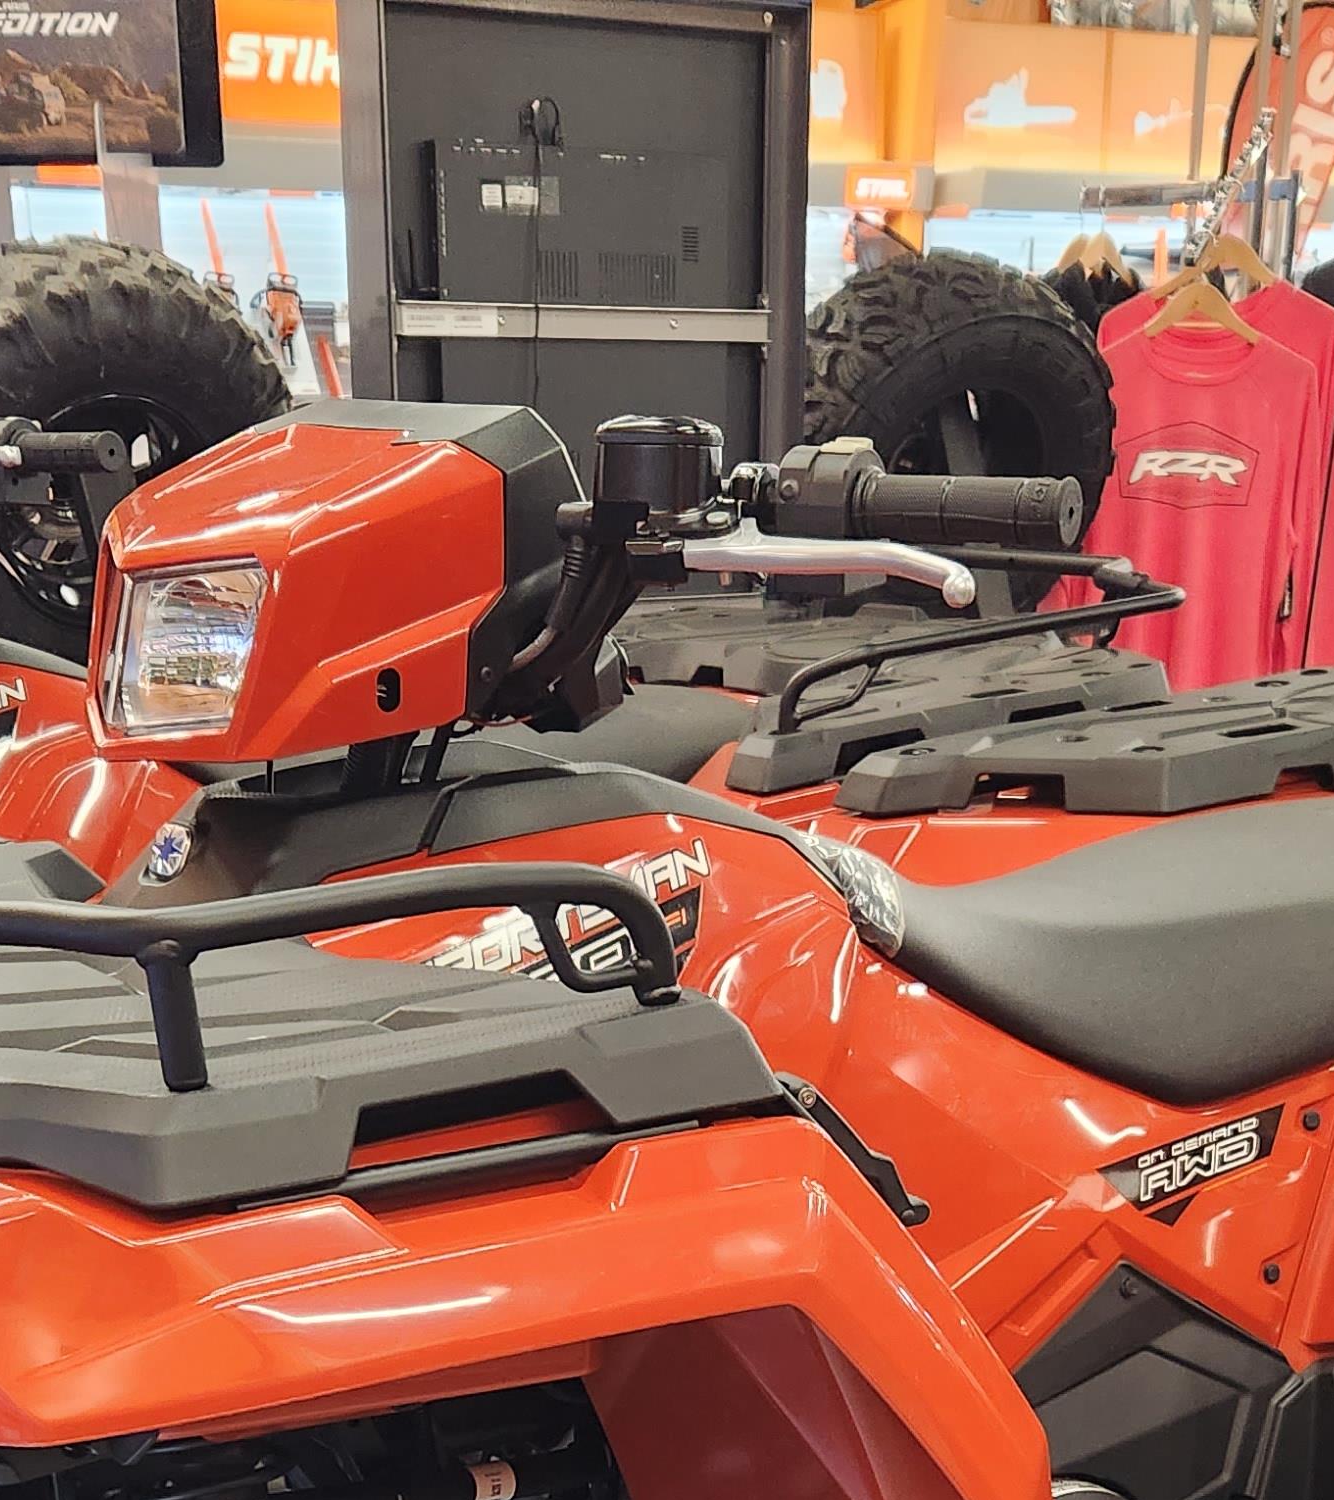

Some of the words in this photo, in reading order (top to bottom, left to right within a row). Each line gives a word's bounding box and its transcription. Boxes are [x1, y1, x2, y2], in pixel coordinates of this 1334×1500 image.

[224, 31, 340, 88] STIH
[1127, 450, 1248, 487] RZR
[1137, 1151, 1166, 1169] ON
[1171, 1115, 1260, 1158] DEMAND
[1139, 1130, 1261, 1203] AWD
